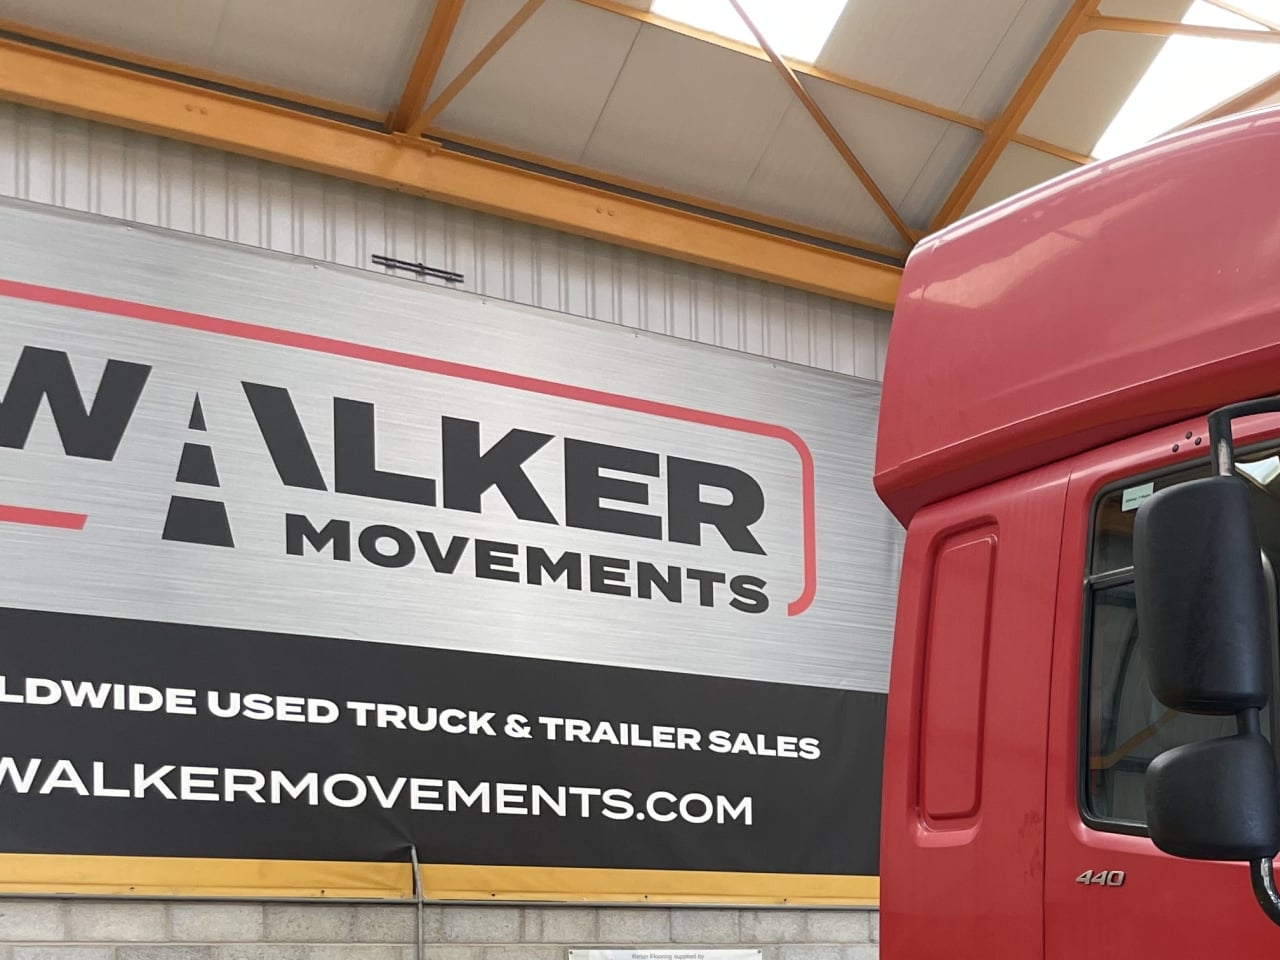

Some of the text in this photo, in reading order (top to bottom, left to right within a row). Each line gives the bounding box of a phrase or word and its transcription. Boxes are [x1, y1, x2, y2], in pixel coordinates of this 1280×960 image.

[0, 345, 767, 556] WALKER
[285, 513, 769, 613] MOVEMENTS
[0, 675, 821, 760] LDWIDE USED TRUCK & TRAILER SALES
[0, 757, 753, 825] WALKERMOVEMENTS.COM
[1075, 870, 1125, 886] 440
